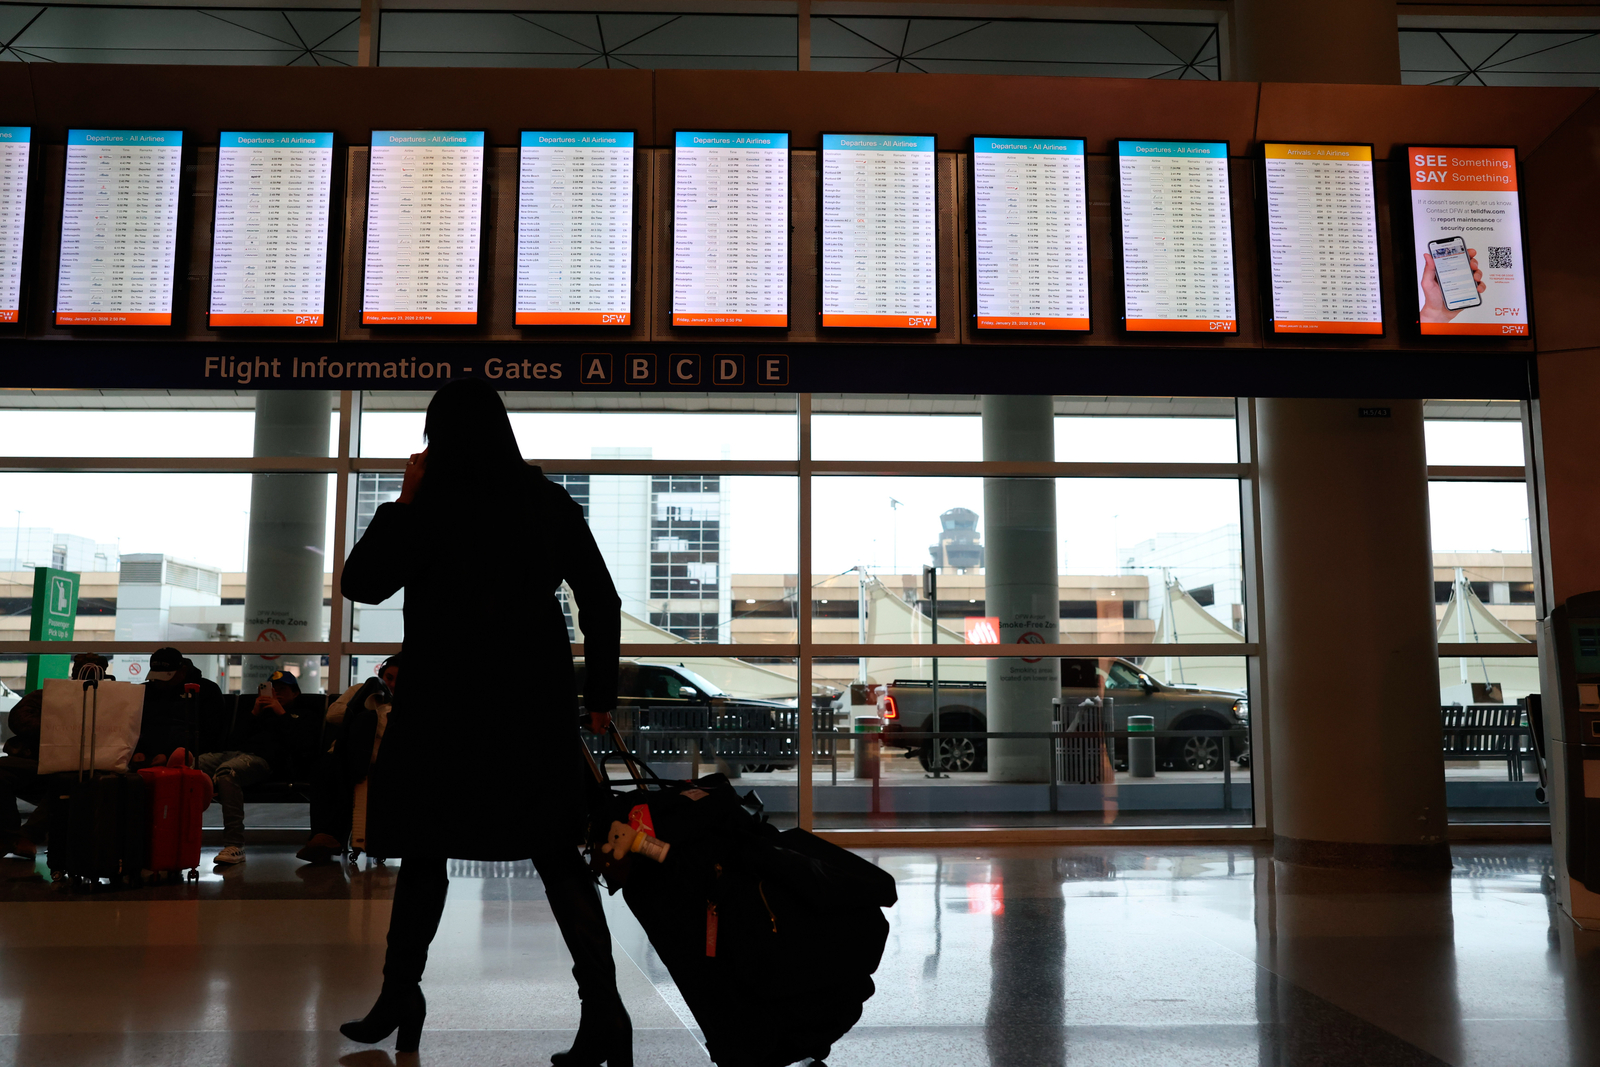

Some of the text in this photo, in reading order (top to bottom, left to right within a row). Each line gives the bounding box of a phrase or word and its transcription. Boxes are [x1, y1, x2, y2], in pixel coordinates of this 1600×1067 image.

[1415, 155, 1511, 169] SEE Something,
[1416, 171, 1511, 184] SAY Something.
[1495, 308, 1519, 316] DFW
[296, 316, 319, 324] DFW
[602, 315, 625, 323] DFW
[909, 318, 931, 326] DFW
[204, 356, 281, 384] Flight
[292, 356, 451, 379] Information
[484, 358, 562, 379] Gates
[586, 358, 605, 379] A
[633, 359, 648, 379] B
[676, 359, 693, 380] C
[720, 360, 737, 380] D
[766, 360, 780, 380] E
[48, 619, 69, 629] Passenger
[288, 618, 308, 626] Zone
[58, 630, 64, 639] Up
